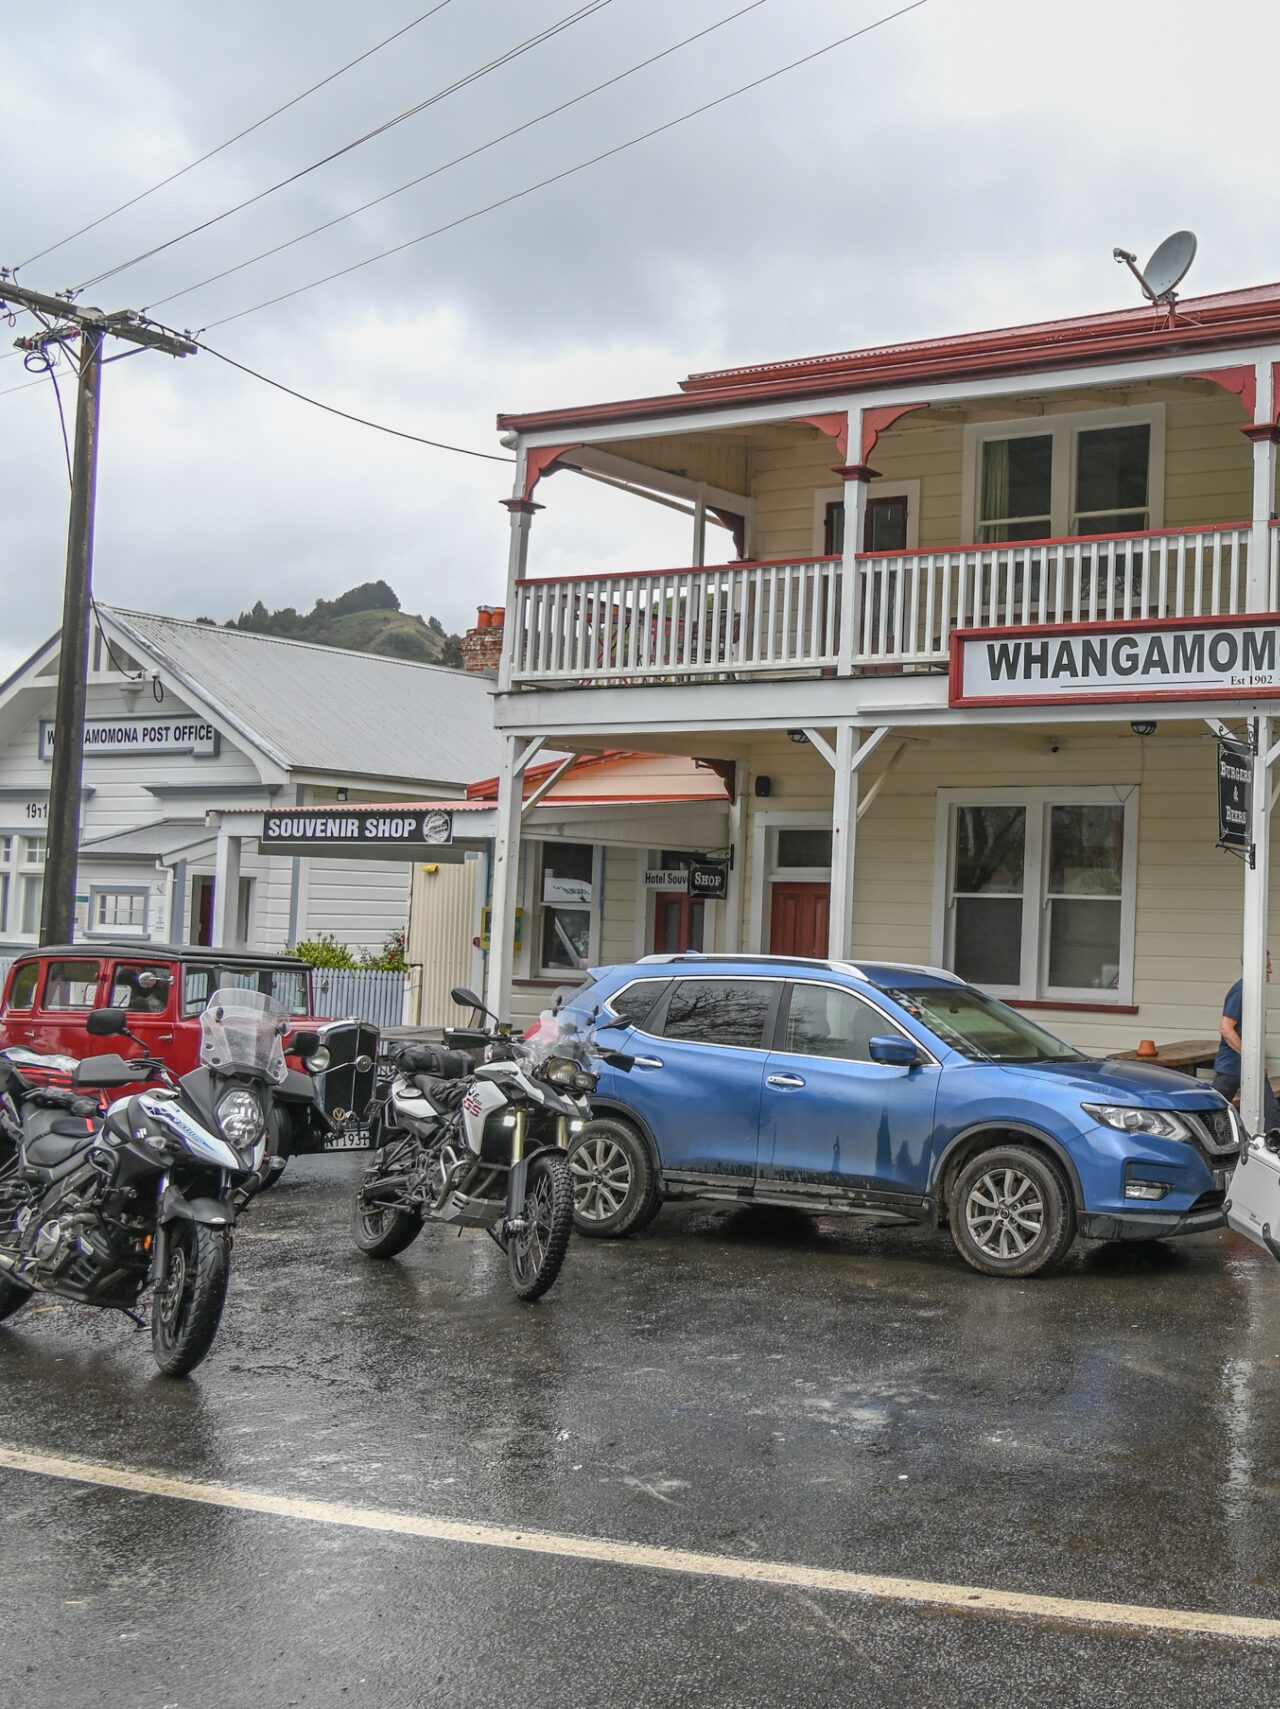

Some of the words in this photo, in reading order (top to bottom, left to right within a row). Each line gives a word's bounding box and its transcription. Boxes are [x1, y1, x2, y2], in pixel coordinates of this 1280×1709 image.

[1231, 675, 1245, 685] Est
[1249, 674, 1273, 685] 1902
[47, 727, 138, 745] WAMOMONA
[142, 727, 170, 742] POST
[173, 724, 213, 742] OFFICE
[1233, 785, 1239, 801] &
[268, 819, 359, 837] SOUVENIR
[364, 818, 416, 837] SHOP
[645, 872, 666, 884] Hotel
